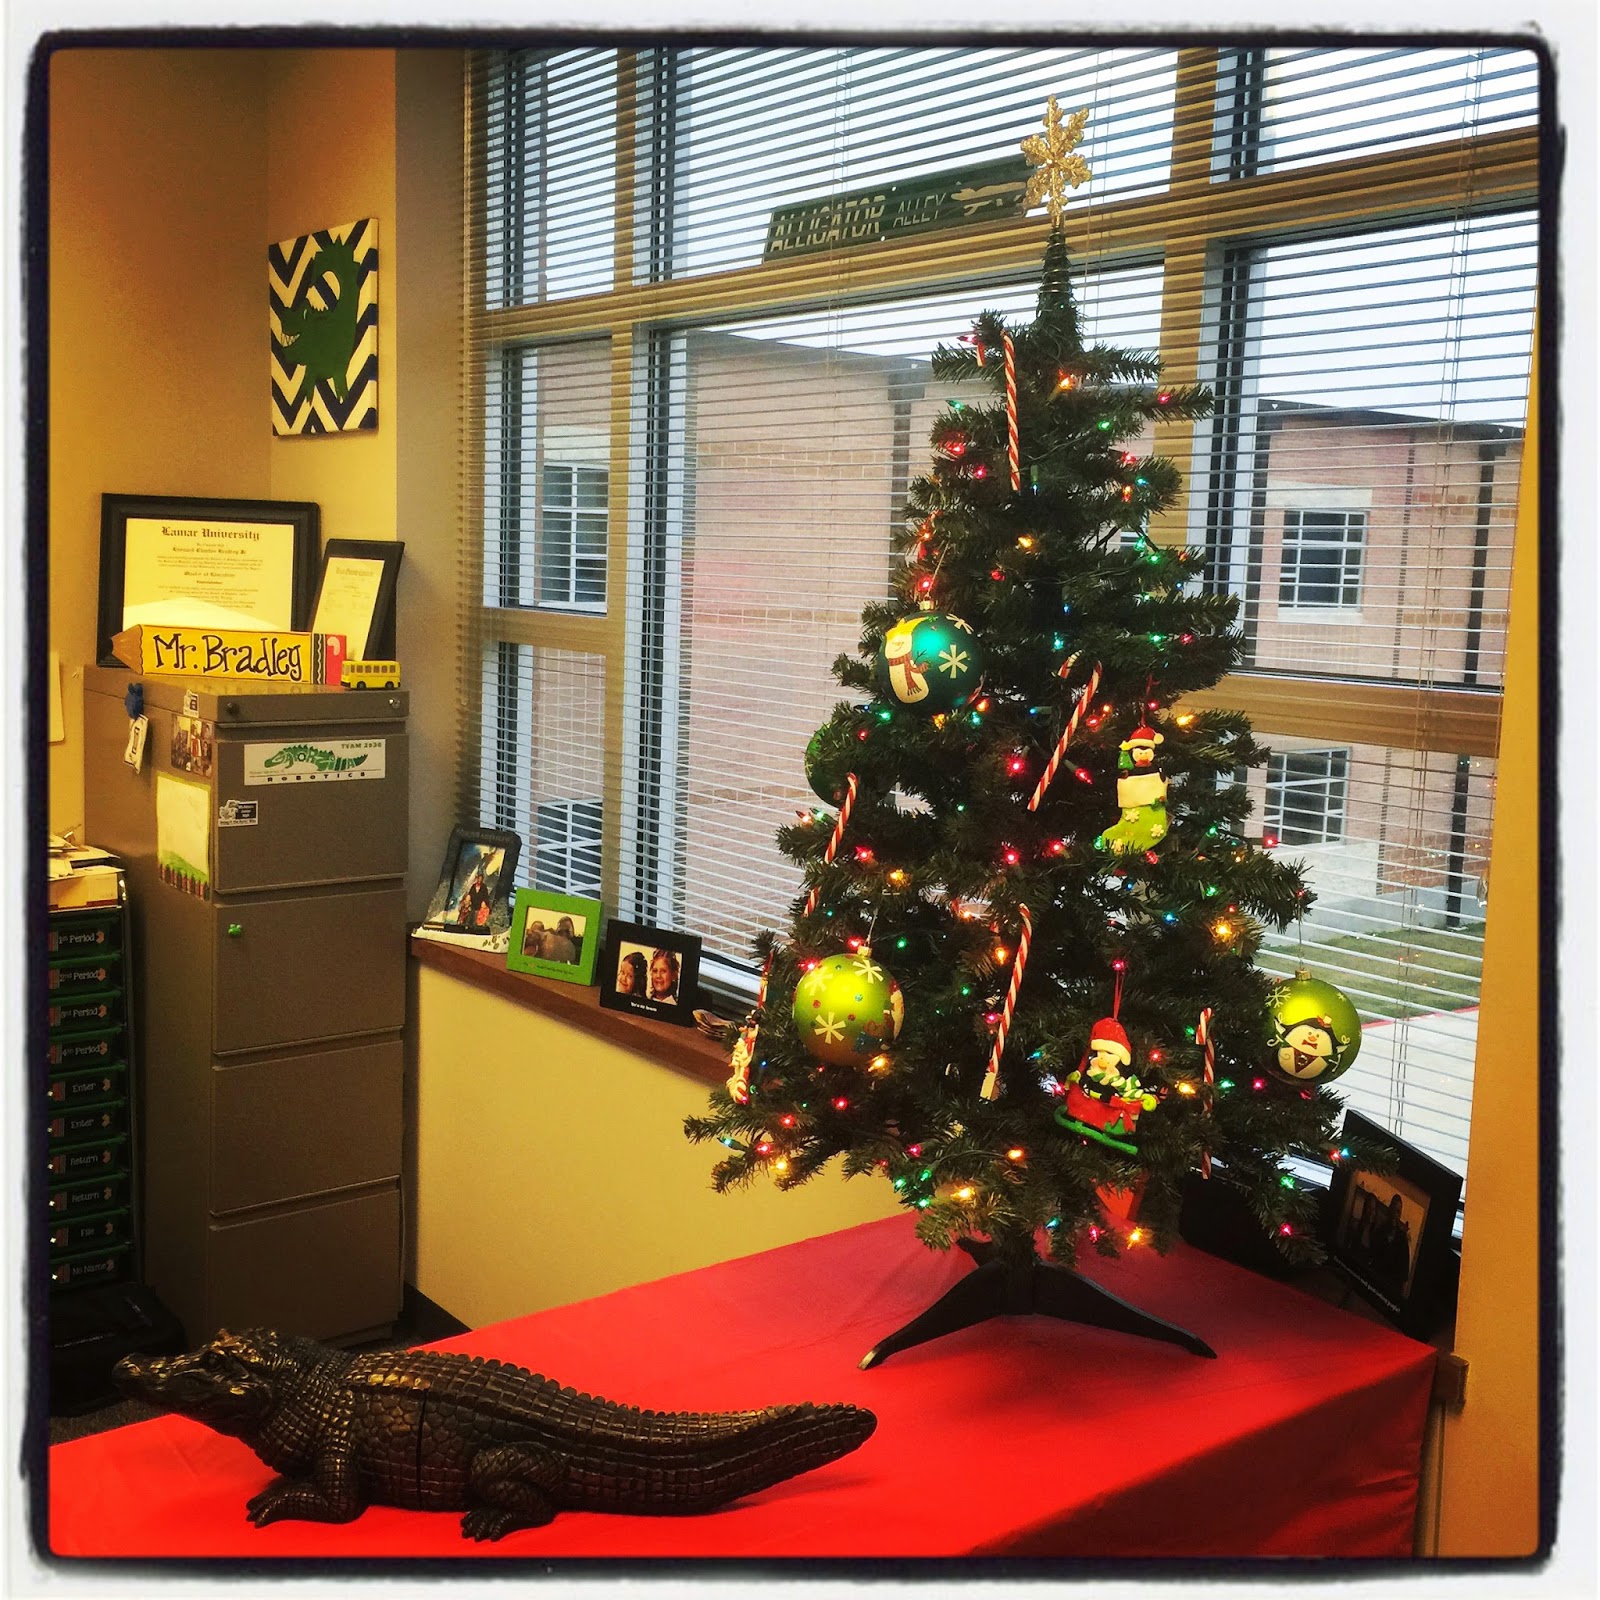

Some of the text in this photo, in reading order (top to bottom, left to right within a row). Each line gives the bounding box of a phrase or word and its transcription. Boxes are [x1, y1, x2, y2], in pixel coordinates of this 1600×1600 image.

[770, 191, 948, 252] ALLIGATOR ALLEY
[161, 526, 260, 541] Lamar University
[153, 633, 302, 682] Mr. Bradley
[267, 771, 366, 783] ROBOTICS
[69, 934, 95, 944] Period
[73, 970, 99, 980] Period
[73, 1007, 98, 1017] Period
[75, 1045, 101, 1056] Period
[72, 1083, 97, 1093] Enter
[71, 1118, 95, 1129] Enter
[70, 1154, 99, 1166] Return
[72, 1191, 100, 1203] Return
[84, 1263, 107, 1274] Name
